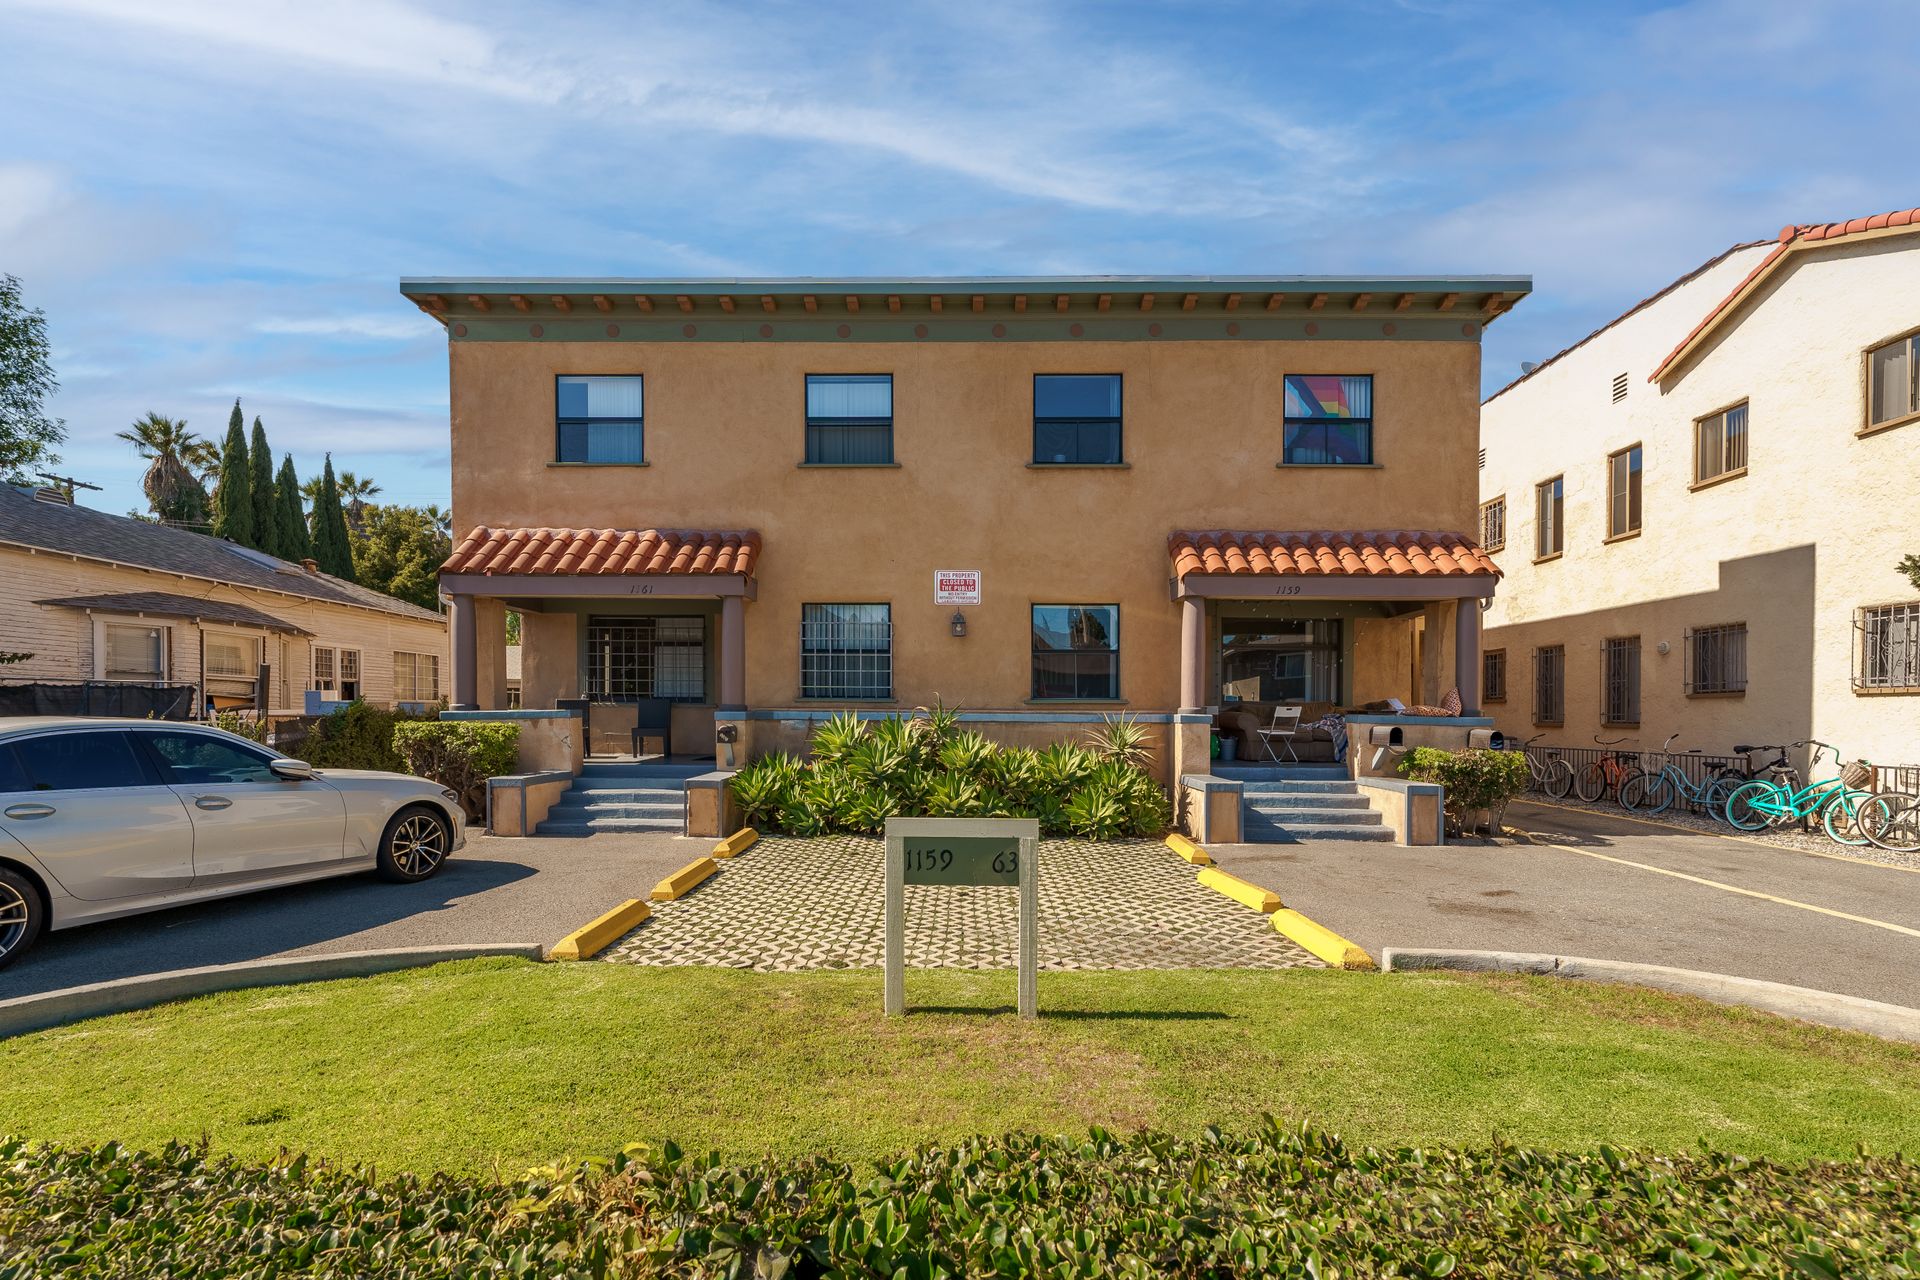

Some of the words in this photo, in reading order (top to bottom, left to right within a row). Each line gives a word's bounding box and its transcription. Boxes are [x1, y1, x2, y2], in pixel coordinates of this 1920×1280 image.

[1276, 585, 1301, 595] 1159
[906, 849, 953, 872] 1159
[992, 851, 1018, 874] 63
